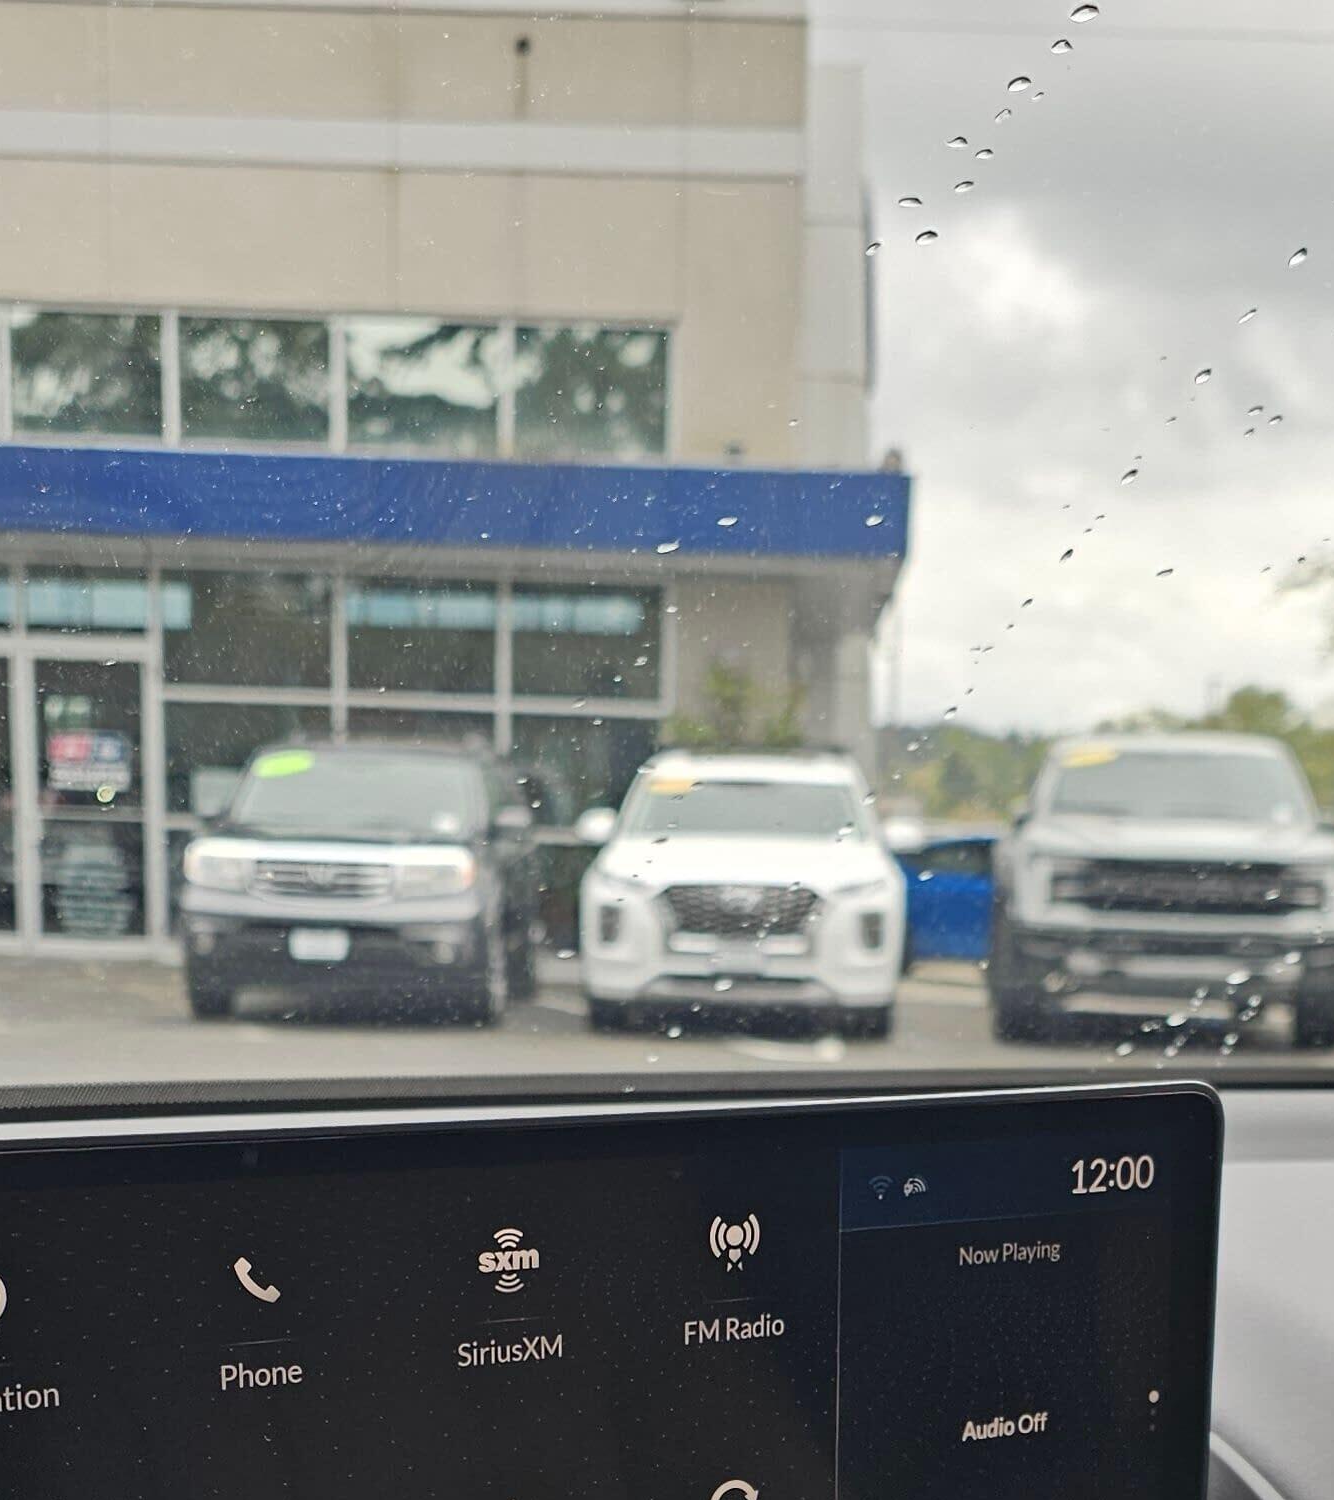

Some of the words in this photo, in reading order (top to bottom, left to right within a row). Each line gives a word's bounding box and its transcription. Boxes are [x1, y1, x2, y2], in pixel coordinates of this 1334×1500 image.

[1071, 1155, 1155, 1194] 12:00
[478, 1245, 540, 1273] sxm
[959, 1244, 996, 1266] Now
[1002, 1239, 1061, 1265] Playing
[684, 1319, 720, 1346] FM
[726, 1314, 785, 1341] Radio
[457, 1334, 563, 1367] SiriusXM
[220, 1361, 303, 1391] Phone
[961, 1416, 1016, 1442] Audio
[1017, 1411, 1048, 1434] Off
